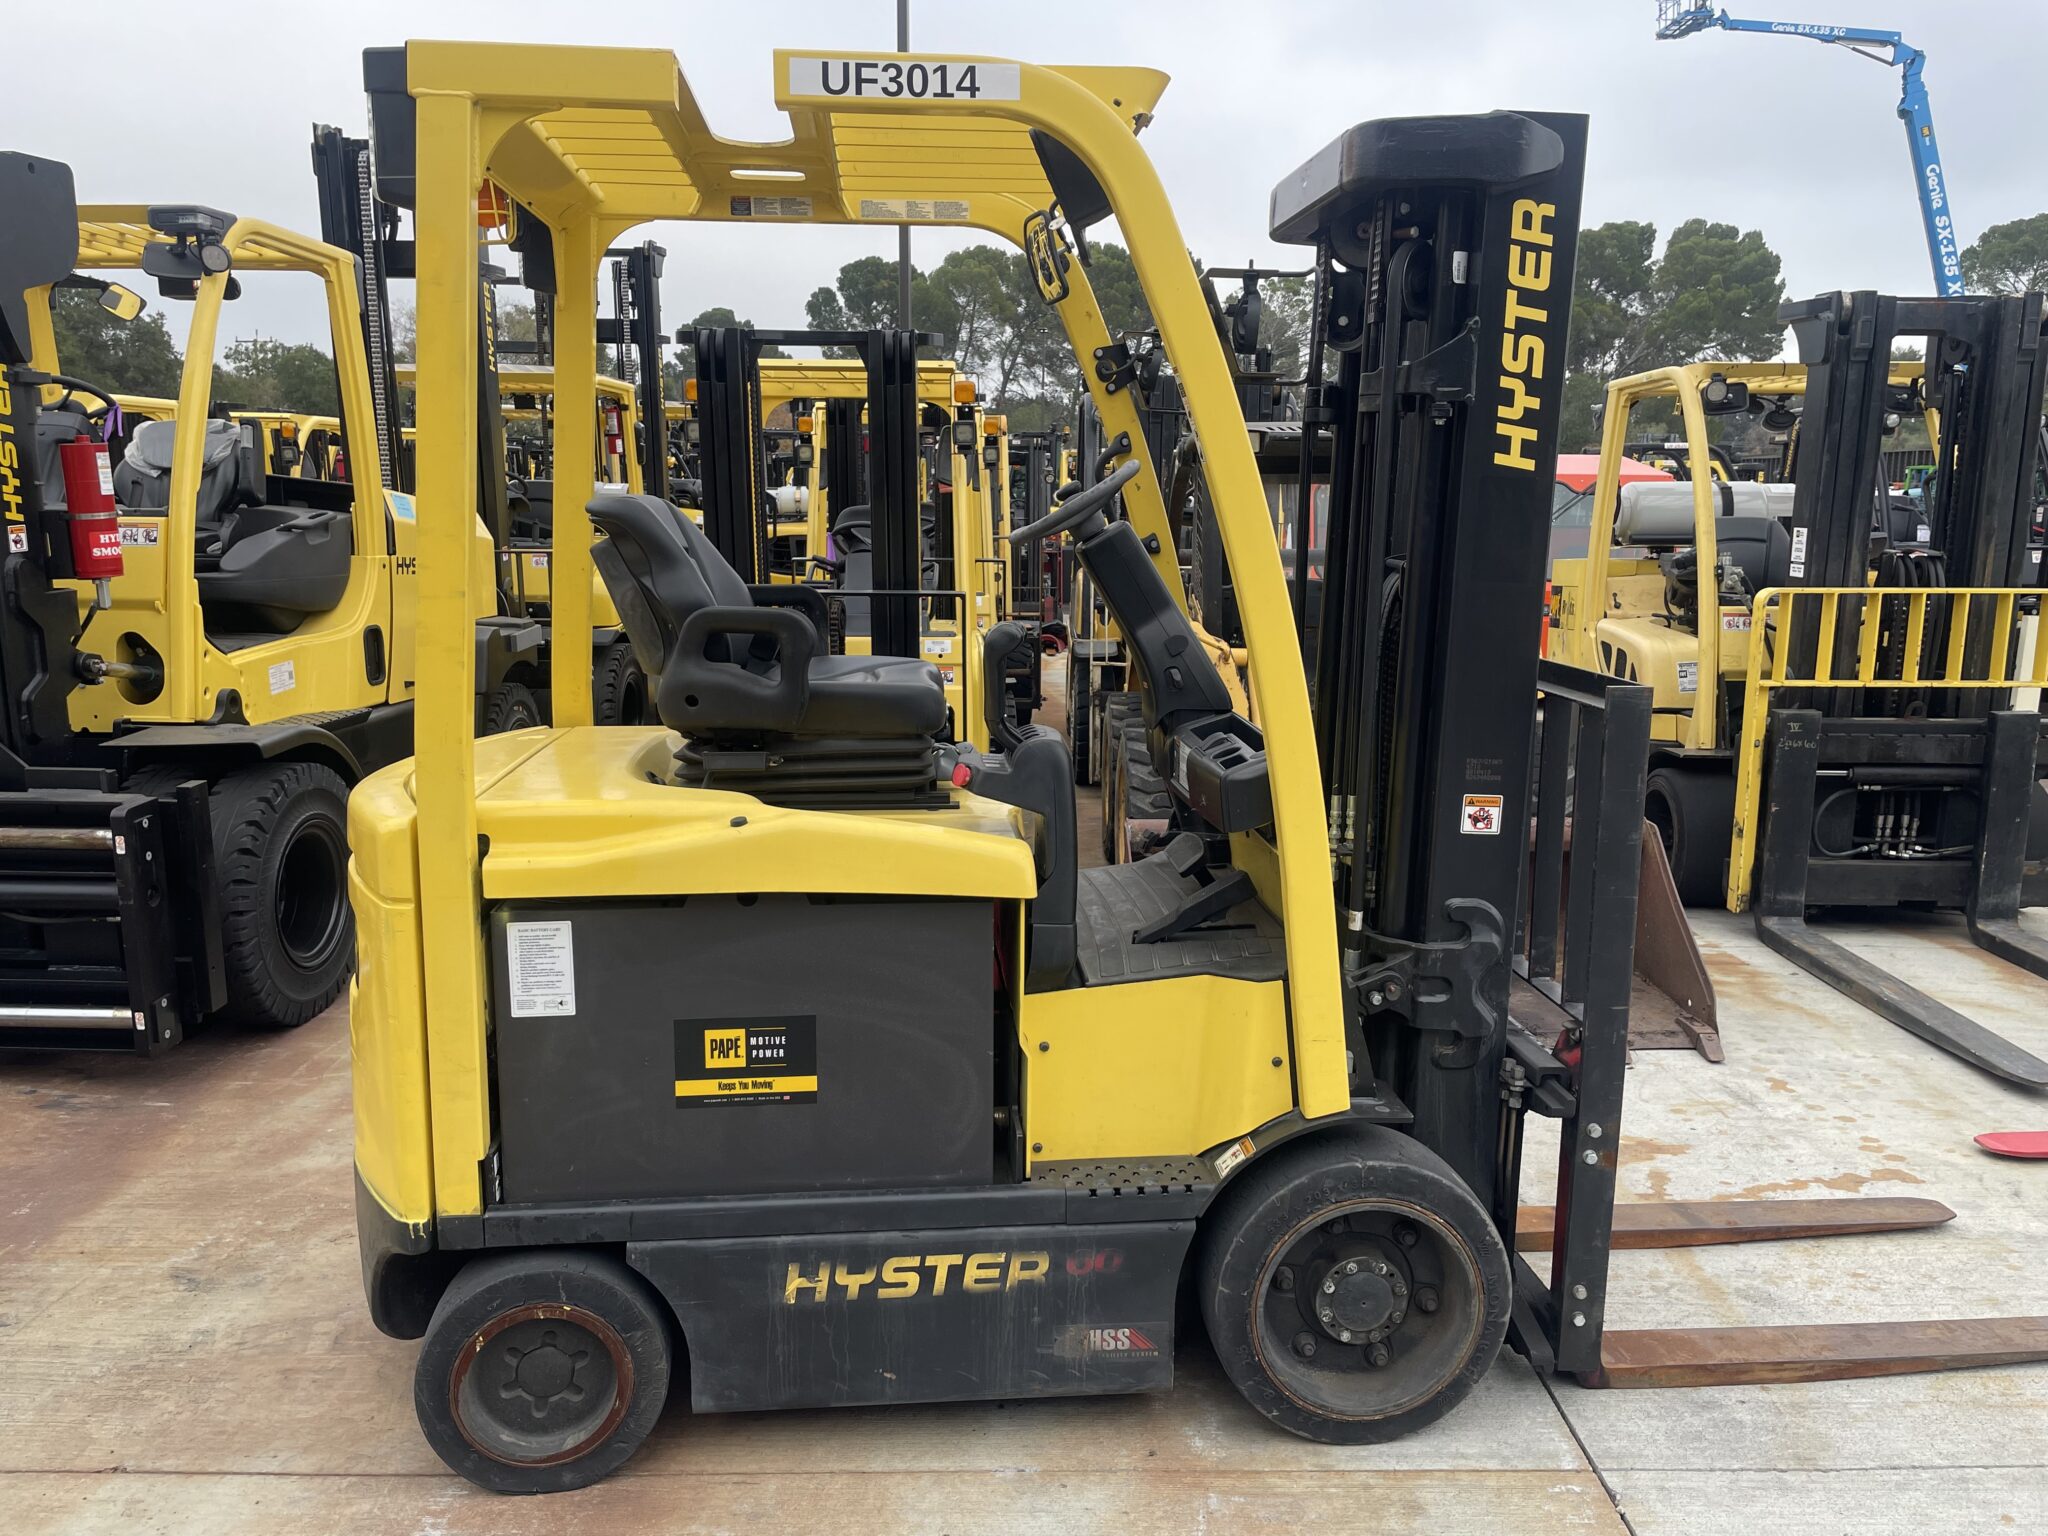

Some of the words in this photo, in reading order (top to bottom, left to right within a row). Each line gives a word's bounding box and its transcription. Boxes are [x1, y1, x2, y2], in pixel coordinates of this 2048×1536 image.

[1772, 22, 1794, 32] Genie
[1797, 25, 1831, 36] SX-135
[1832, 27, 1846, 36] XC
[821, 61, 981, 99] UF3014
[1926, 163, 1943, 210] Genie
[1935, 215, 1960, 277] SX-135
[482, 281, 497, 373] HYSTER
[1493, 198, 1556, 472] HYSTER
[749, 1036, 787, 1046] MOTIVE
[752, 1048, 785, 1058] POWER
[717, 1081, 737, 1092] Keeps
[738, 1080, 750, 1090] You
[751, 1079, 774, 1090] Moving
[783, 1250, 1050, 1305] HYSTER
[1088, 1327, 1131, 1351] HSS
